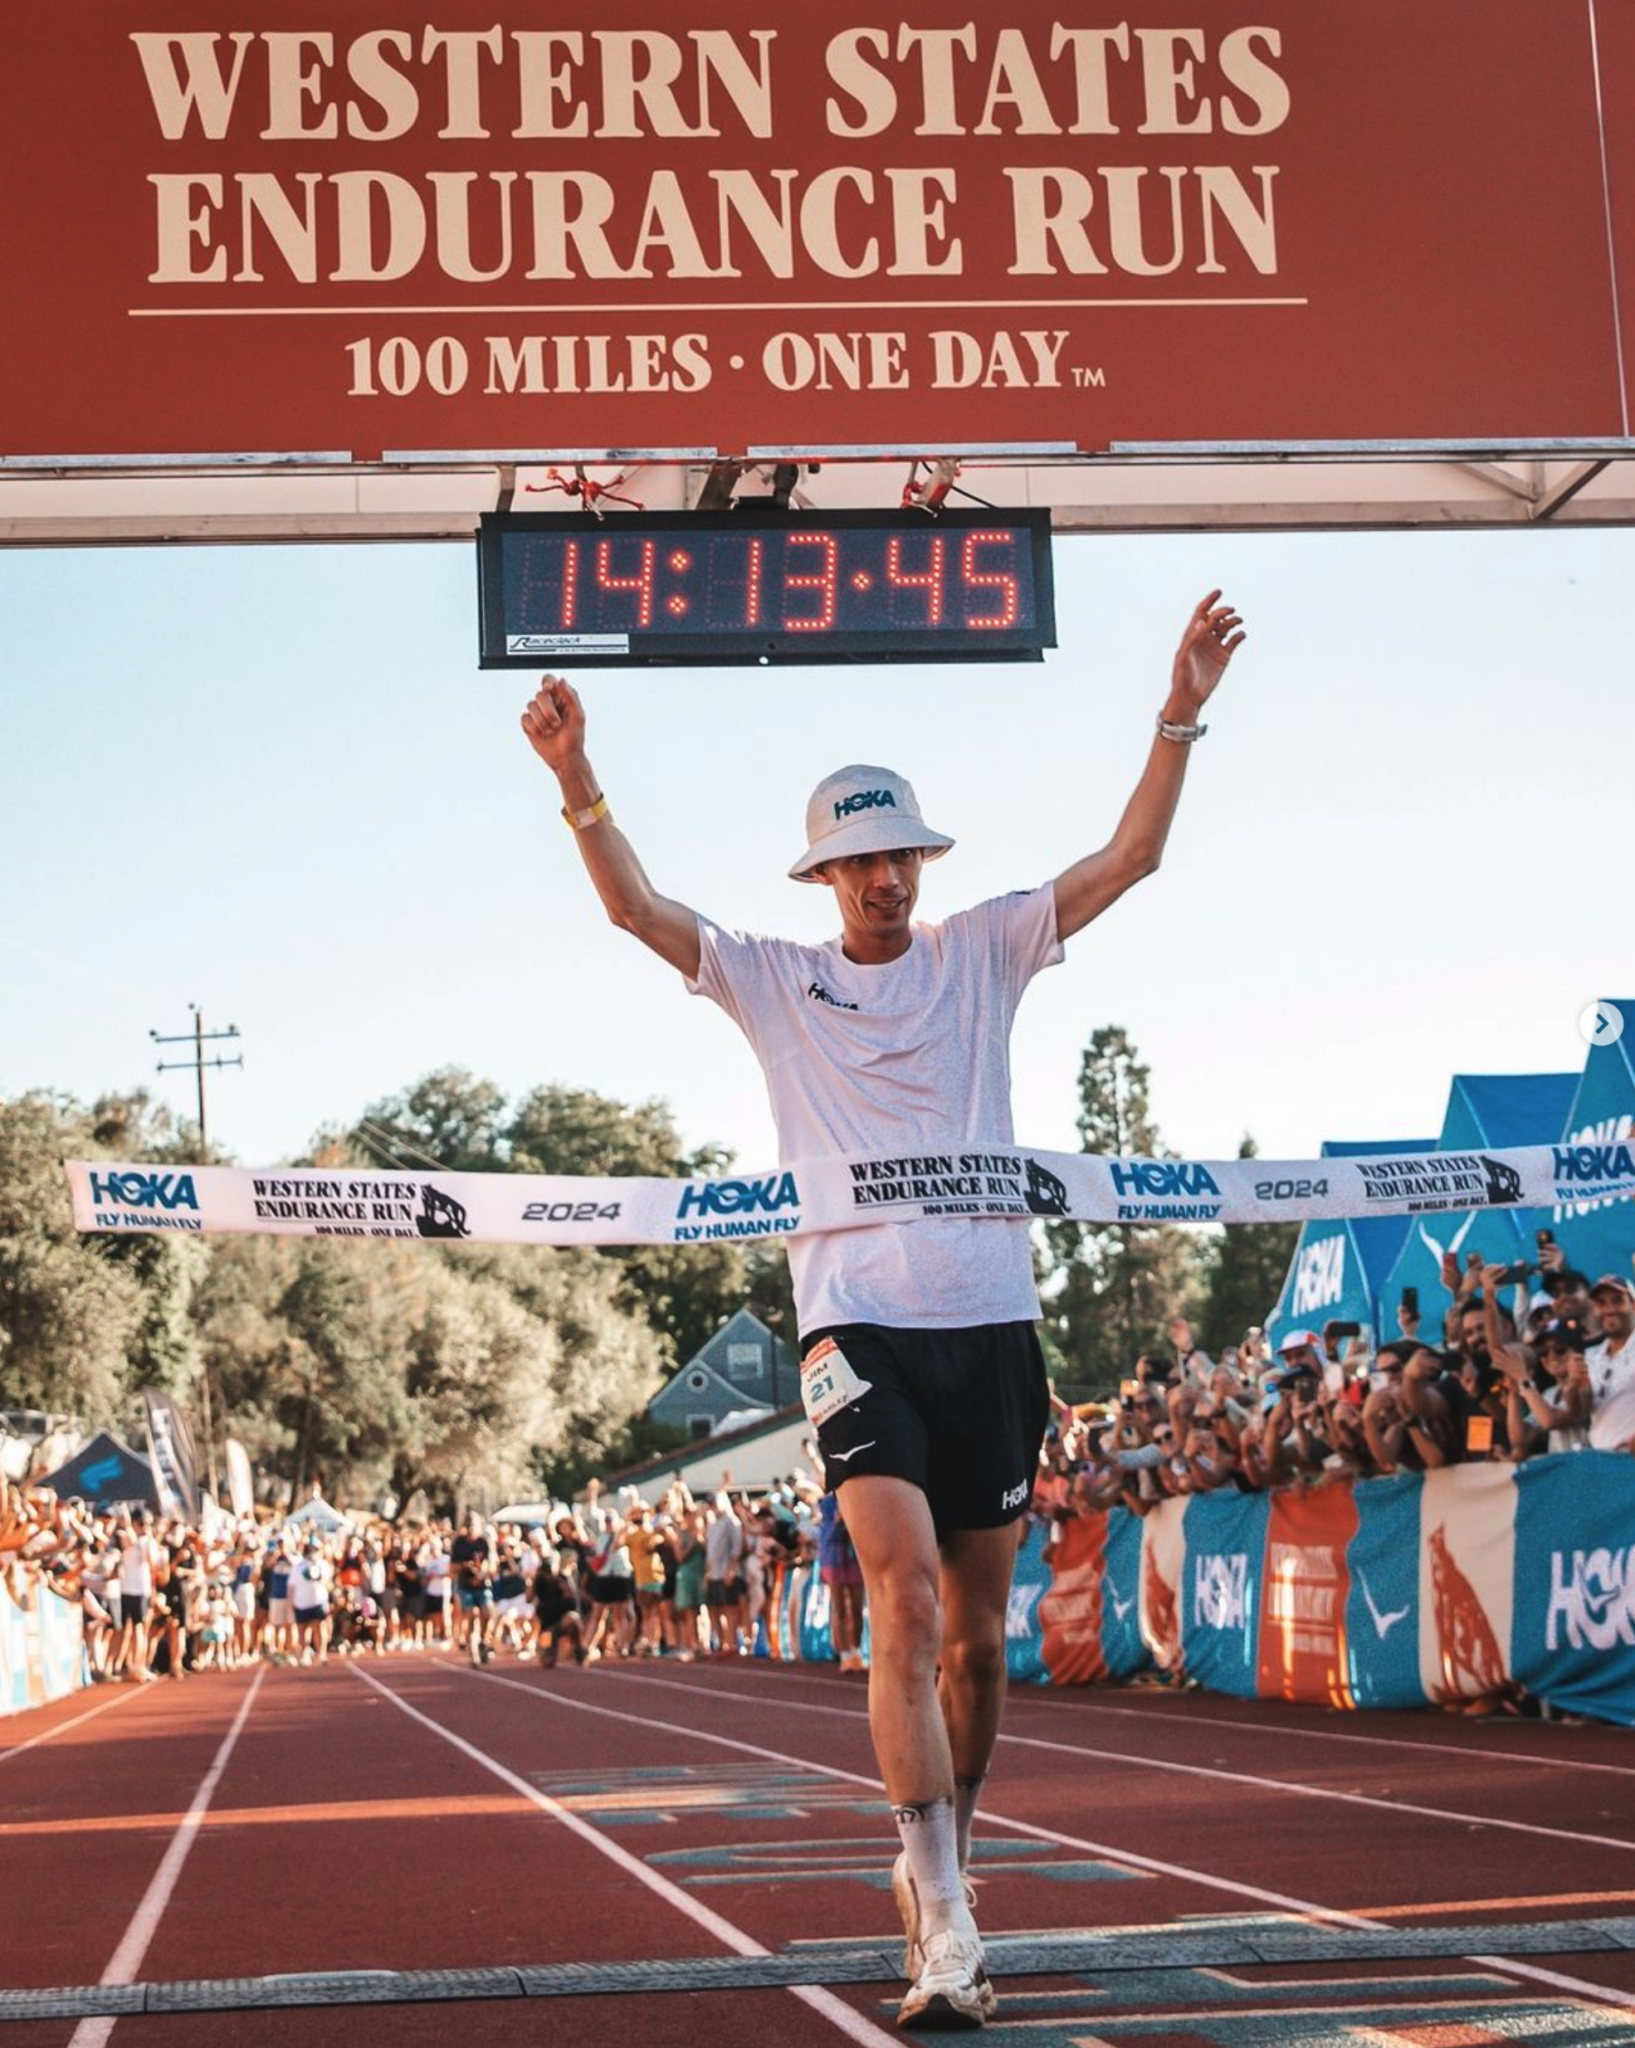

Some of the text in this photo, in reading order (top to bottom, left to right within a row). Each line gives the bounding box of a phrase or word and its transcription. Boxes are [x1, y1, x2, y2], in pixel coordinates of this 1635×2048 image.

[129, 21, 1291, 141] WESTERN STATES
[146, 165, 1280, 283] ENDURANCE RUN
[344, 336, 468, 396] 100
[483, 333, 712, 394] MILES
[762, 331, 910, 391] ONE
[928, 330, 1070, 389] DAY
[834, 790, 896, 820] HOKA
[808, 982, 859, 1010] HO
[849, 1153, 1022, 1182] WESTERN STATES
[1355, 1156, 1481, 1180] WESTERN STATES
[1552, 1146, 1635, 1181] HOKA
[90, 1172, 199, 1210] HOKA
[253, 1180, 416, 1200] WESTERN STATES
[852, 1176, 1022, 1204] ENDURANCE RUN
[1109, 1163, 1222, 1197] HOKA
[1254, 1179, 1329, 1200] 2024
[1364, 1174, 1484, 1198] ENDURANCE RUN
[676, 1171, 801, 1219] HOKA
[922, 1203, 1026, 1215] 100 MILES ONE DAY
[96, 1213, 119, 1226] FLY
[254, 1199, 412, 1221] ENDURANCE RUN
[521, 1202, 622, 1222] 2024
[1117, 1204, 1223, 1220] FLY HUMAN FLY
[674, 1215, 801, 1240] FLY HUMAN FLY
[807, 1362, 828, 1382] JIM
[811, 1375, 834, 1403] 21
[1545, 1545, 1635, 1650] HOK
